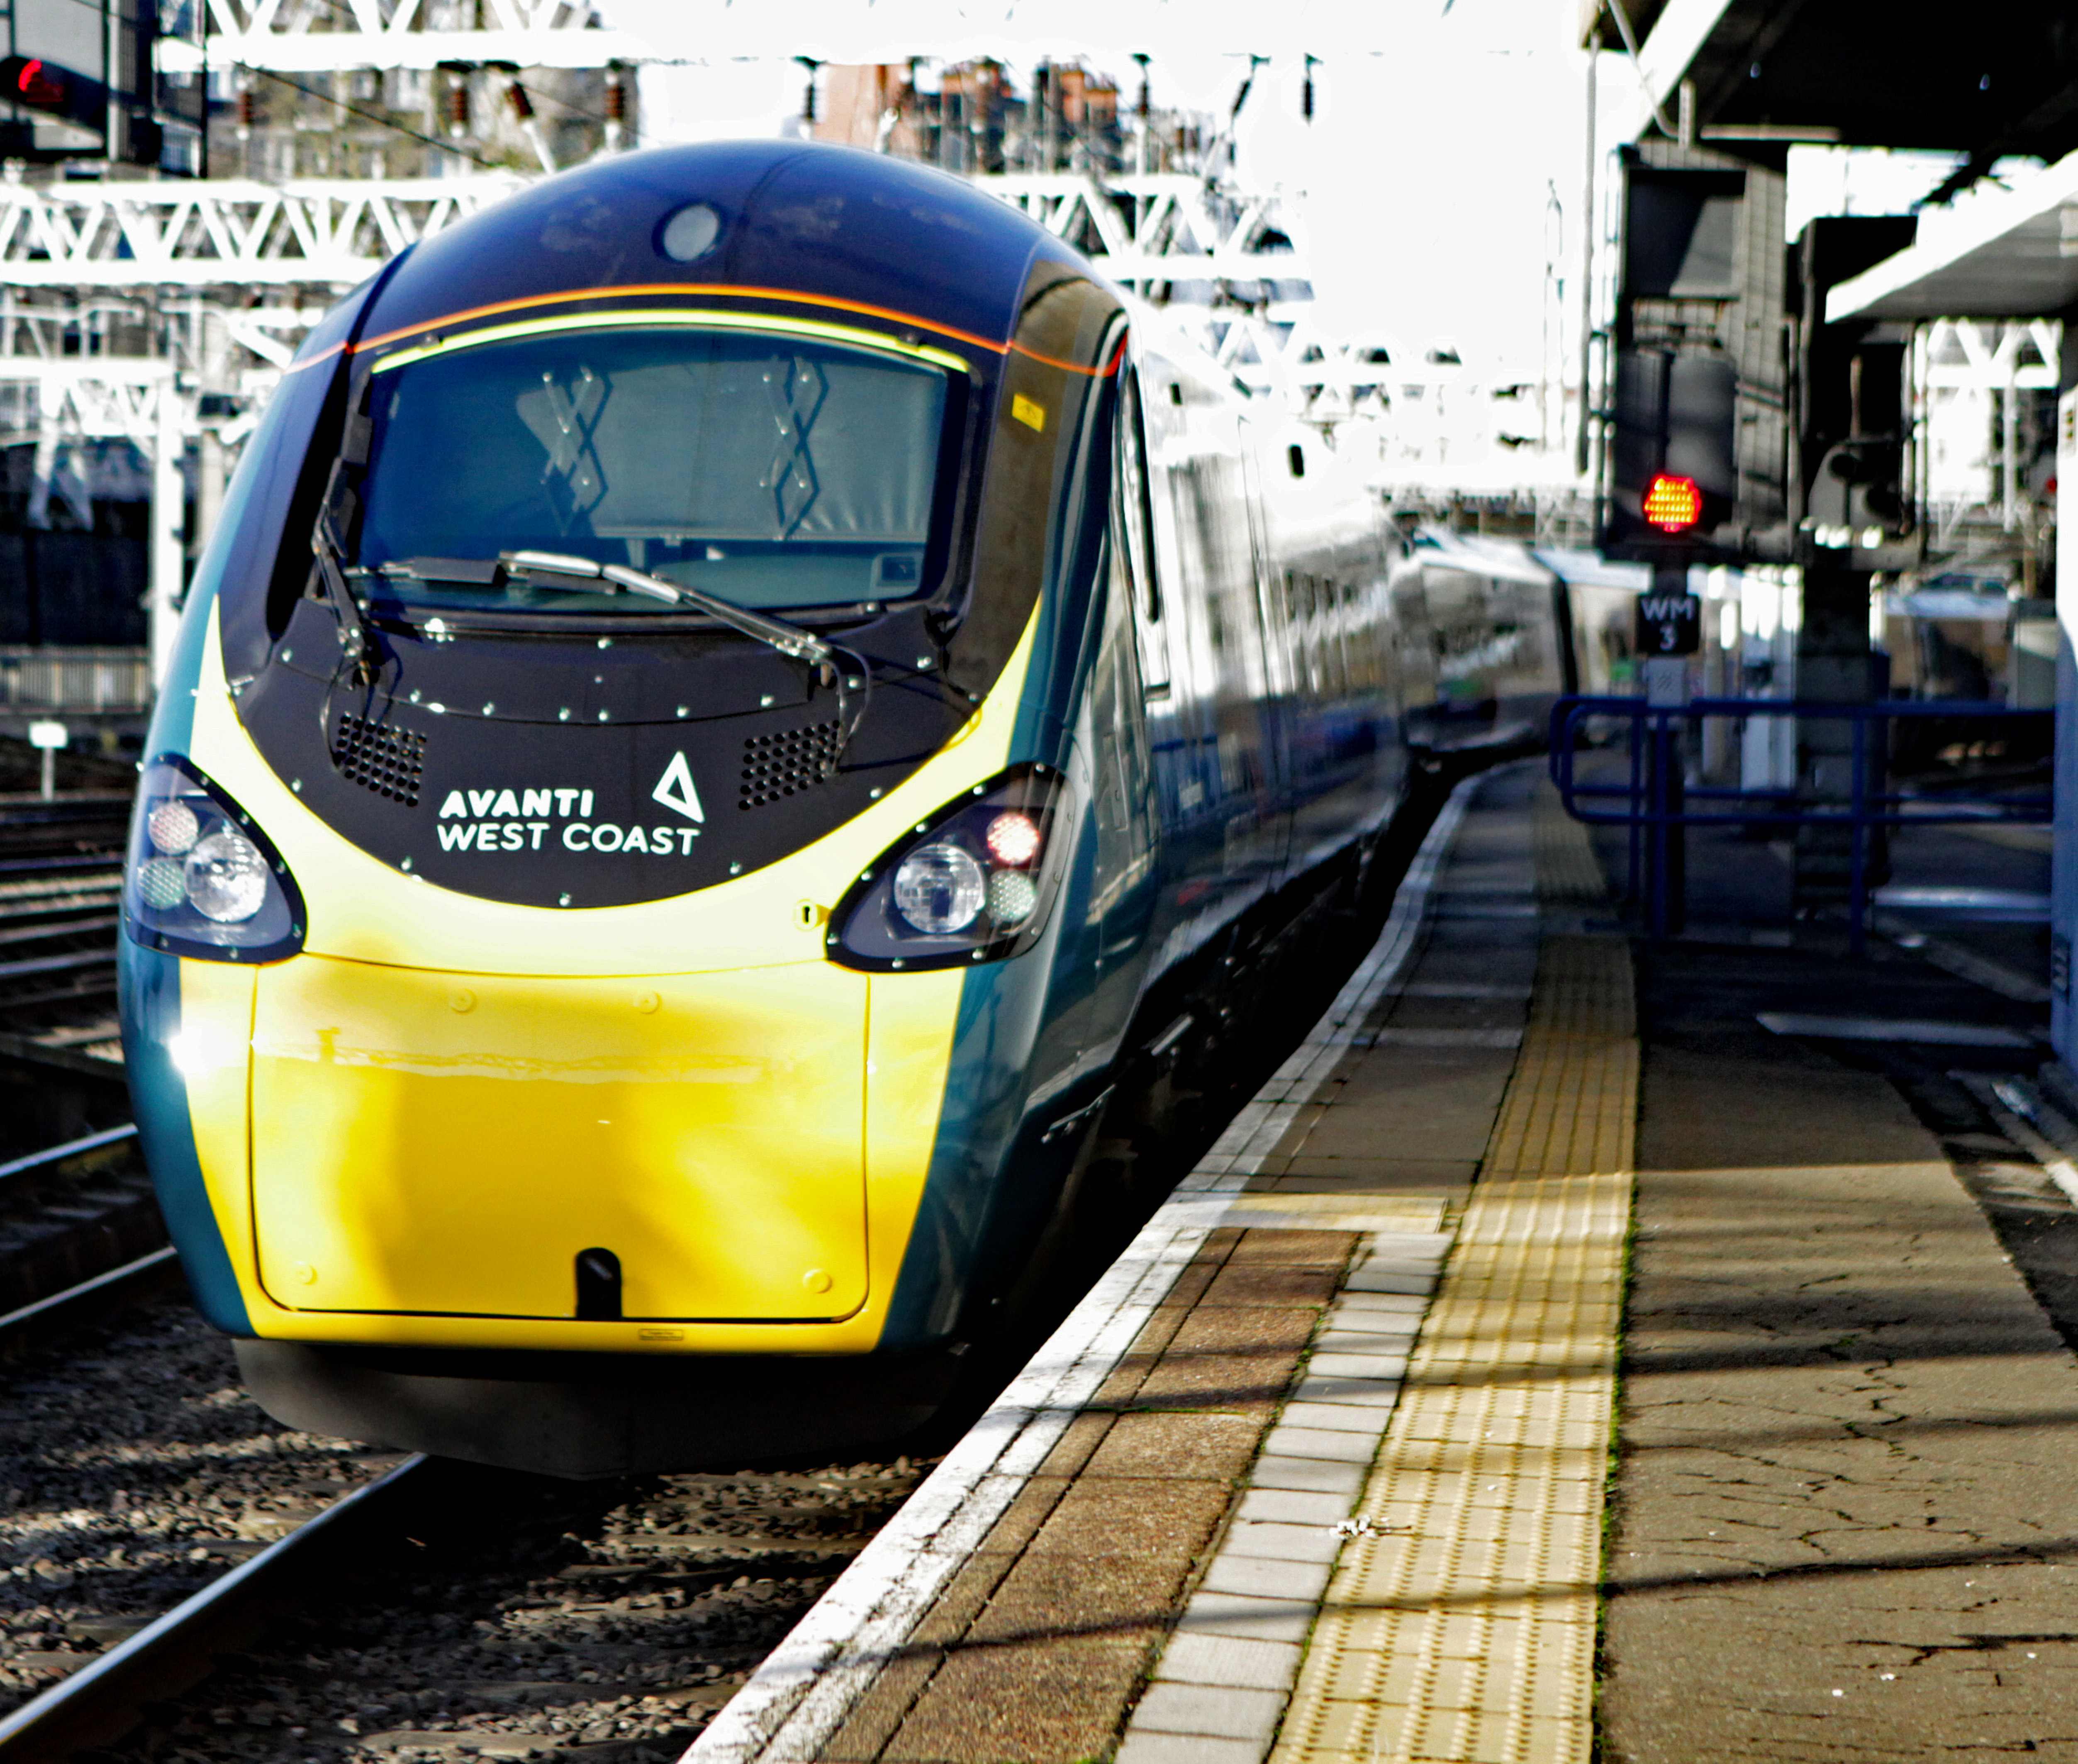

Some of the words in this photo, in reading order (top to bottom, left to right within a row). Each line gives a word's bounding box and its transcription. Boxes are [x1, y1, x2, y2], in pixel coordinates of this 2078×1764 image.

[1641, 597, 1694, 621] WM
[1660, 625, 1676, 650] 3
[439, 789, 593, 818] AVANTI
[437, 823, 550, 851] WEST
[563, 823, 700, 855] COAST
